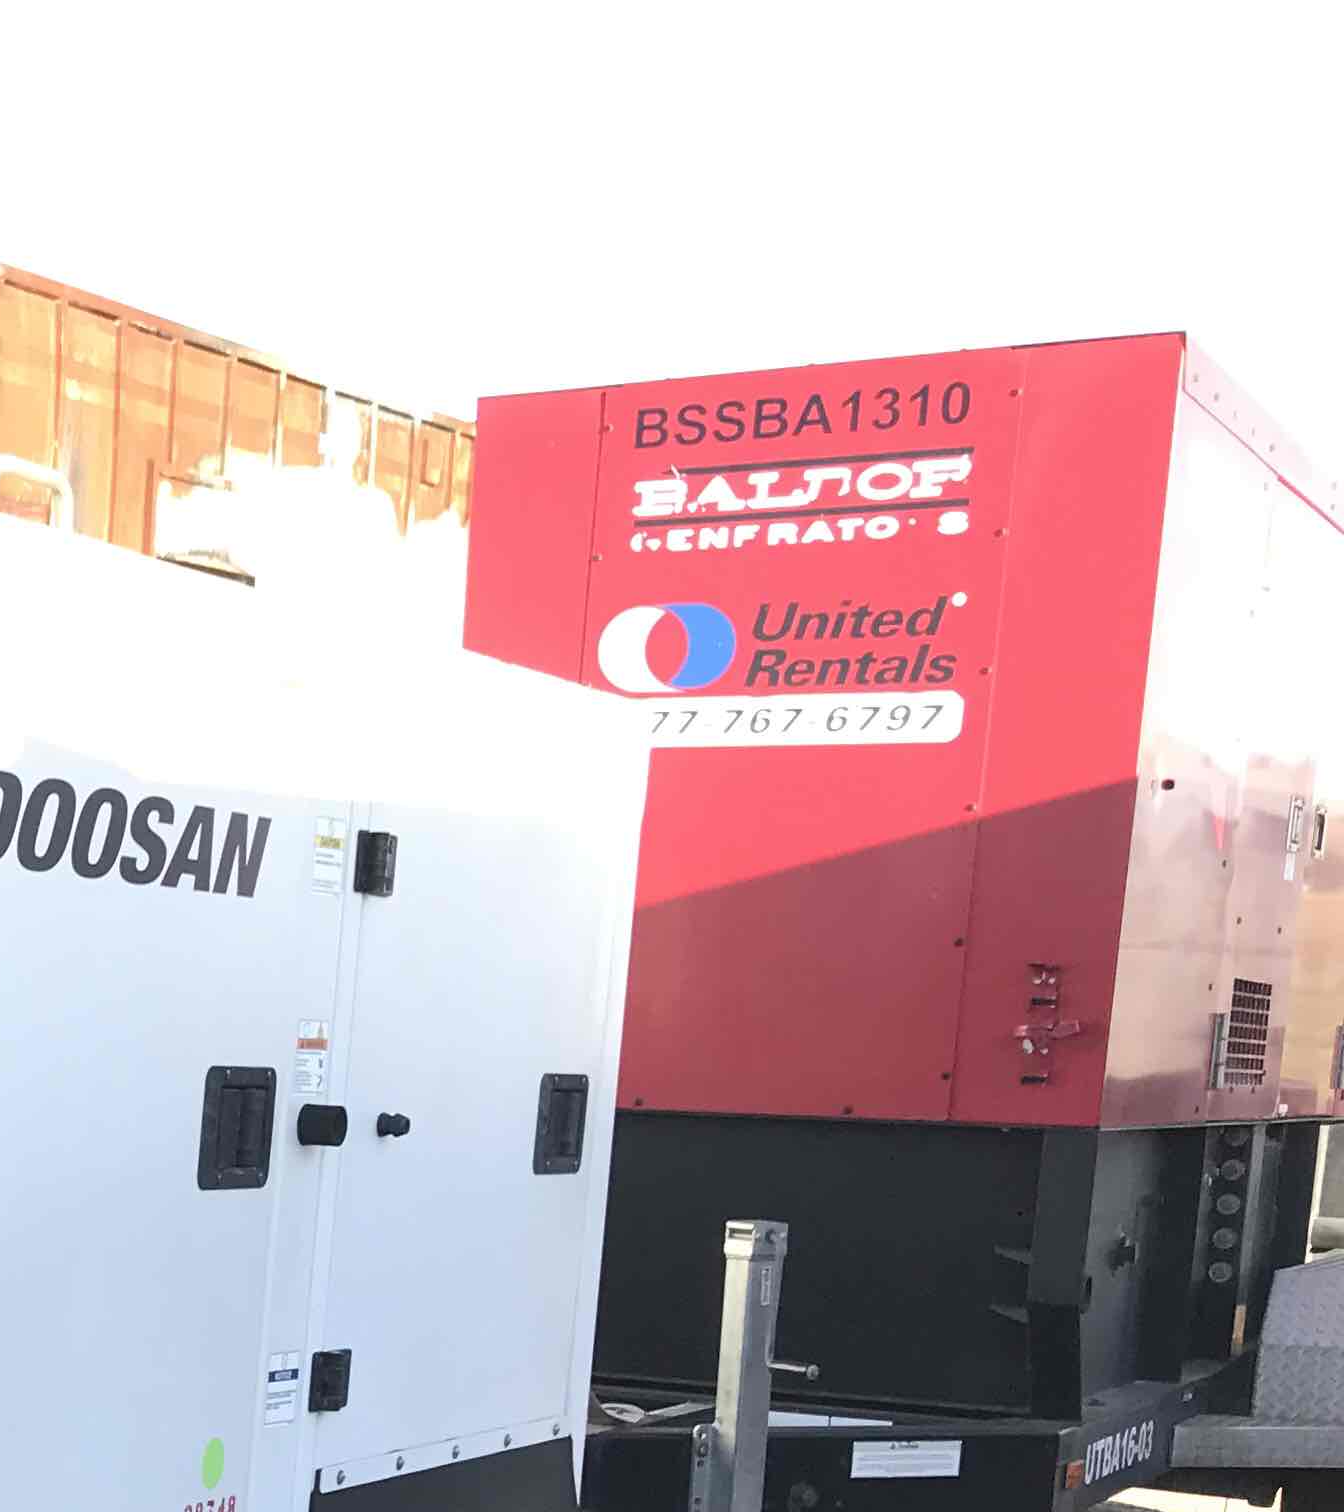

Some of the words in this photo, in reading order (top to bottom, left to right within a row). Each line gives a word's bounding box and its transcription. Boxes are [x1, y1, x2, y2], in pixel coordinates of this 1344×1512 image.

[633, 381, 973, 449] BSSBA1310
[751, 596, 949, 643] United
[744, 644, 958, 688] Rentals
[1084, 1419, 1154, 1485] UTBA16-03
